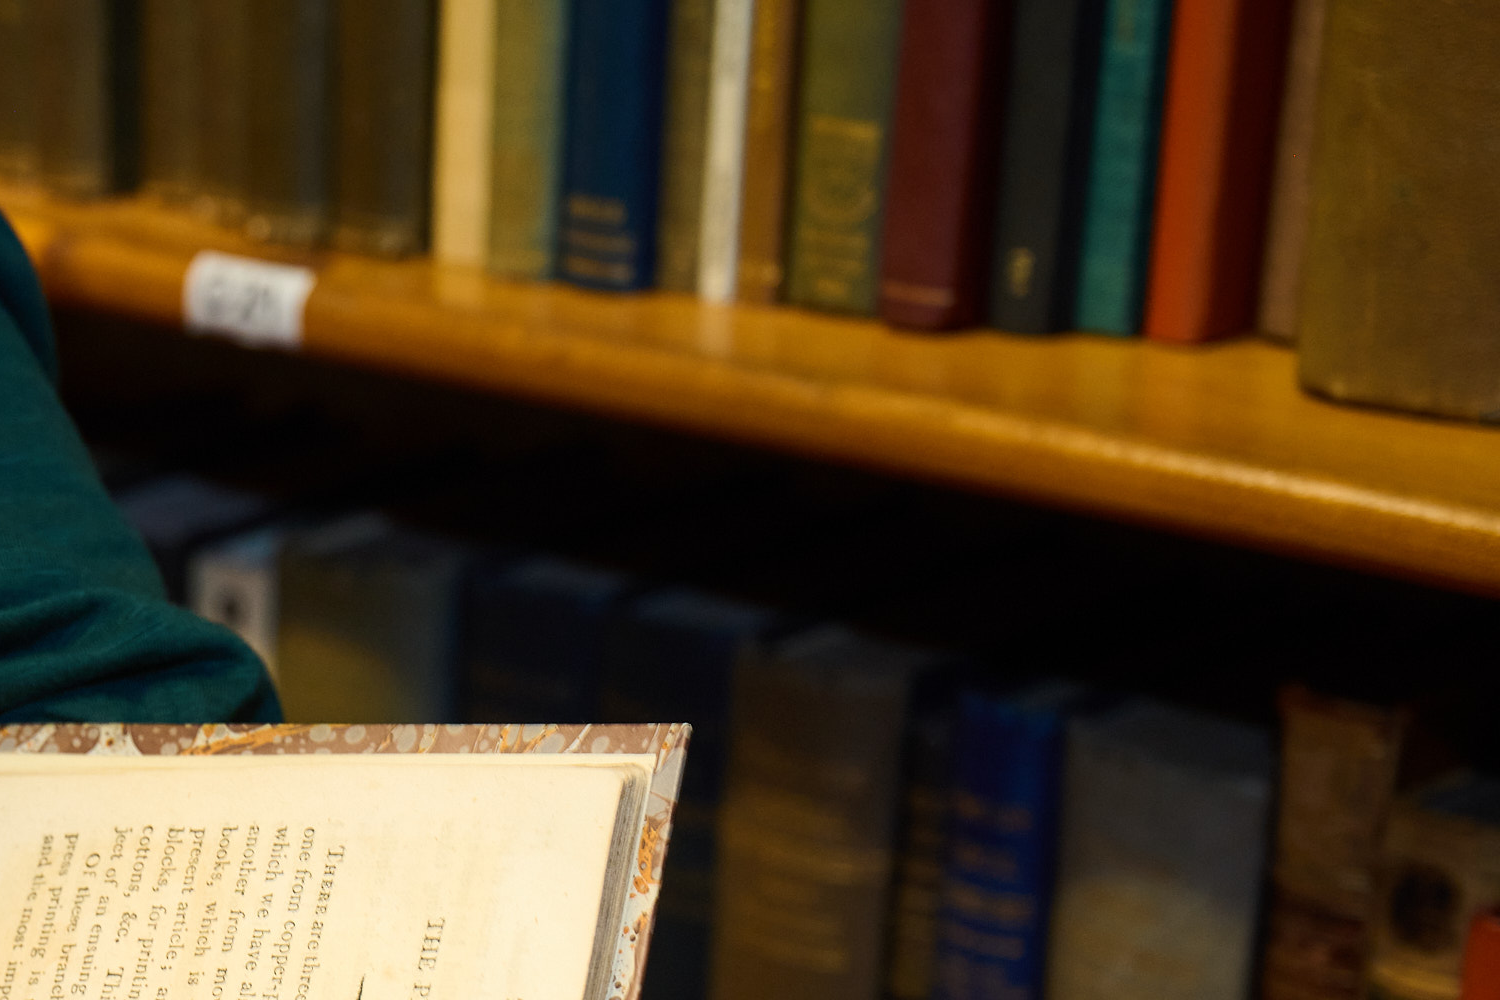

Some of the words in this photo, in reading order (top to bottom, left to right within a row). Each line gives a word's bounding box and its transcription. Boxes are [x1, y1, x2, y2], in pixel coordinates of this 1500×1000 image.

[37, 834, 54, 867] and
[59, 833, 79, 876] press
[114, 827, 133, 860] ject
[123, 825, 154, 897] cottons,
[152, 827, 185, 892] blocks,
[182, 828, 205, 894] present
[206, 825, 238, 887] books,
[235, 825, 260, 896] another
[265, 827, 290, 881] which
[299, 827, 315, 861] one
[83, 853, 101, 878] Of
[104, 868, 119, 888] of
[27, 874, 46, 901] the
[95, 896, 109, 916] an
[257, 893, 273, 918] we
[288, 869, 312, 912] from
[12, 908, 33, 950] most
[30, 886, 63, 958] printing
[67, 887, 90, 932] these
[115, 912, 137, 944] &c.
[148, 905, 167, 930] for
[194, 902, 217, 957] which
[222, 910, 246, 953] from
[245, 929, 270, 971] have
[308, 921, 324, 950] are
[418, 917, 445, 971] THE
[28, 971, 46, 985] is
[71, 924, 102, 995] ensuing
[188, 971, 205, 985] is
